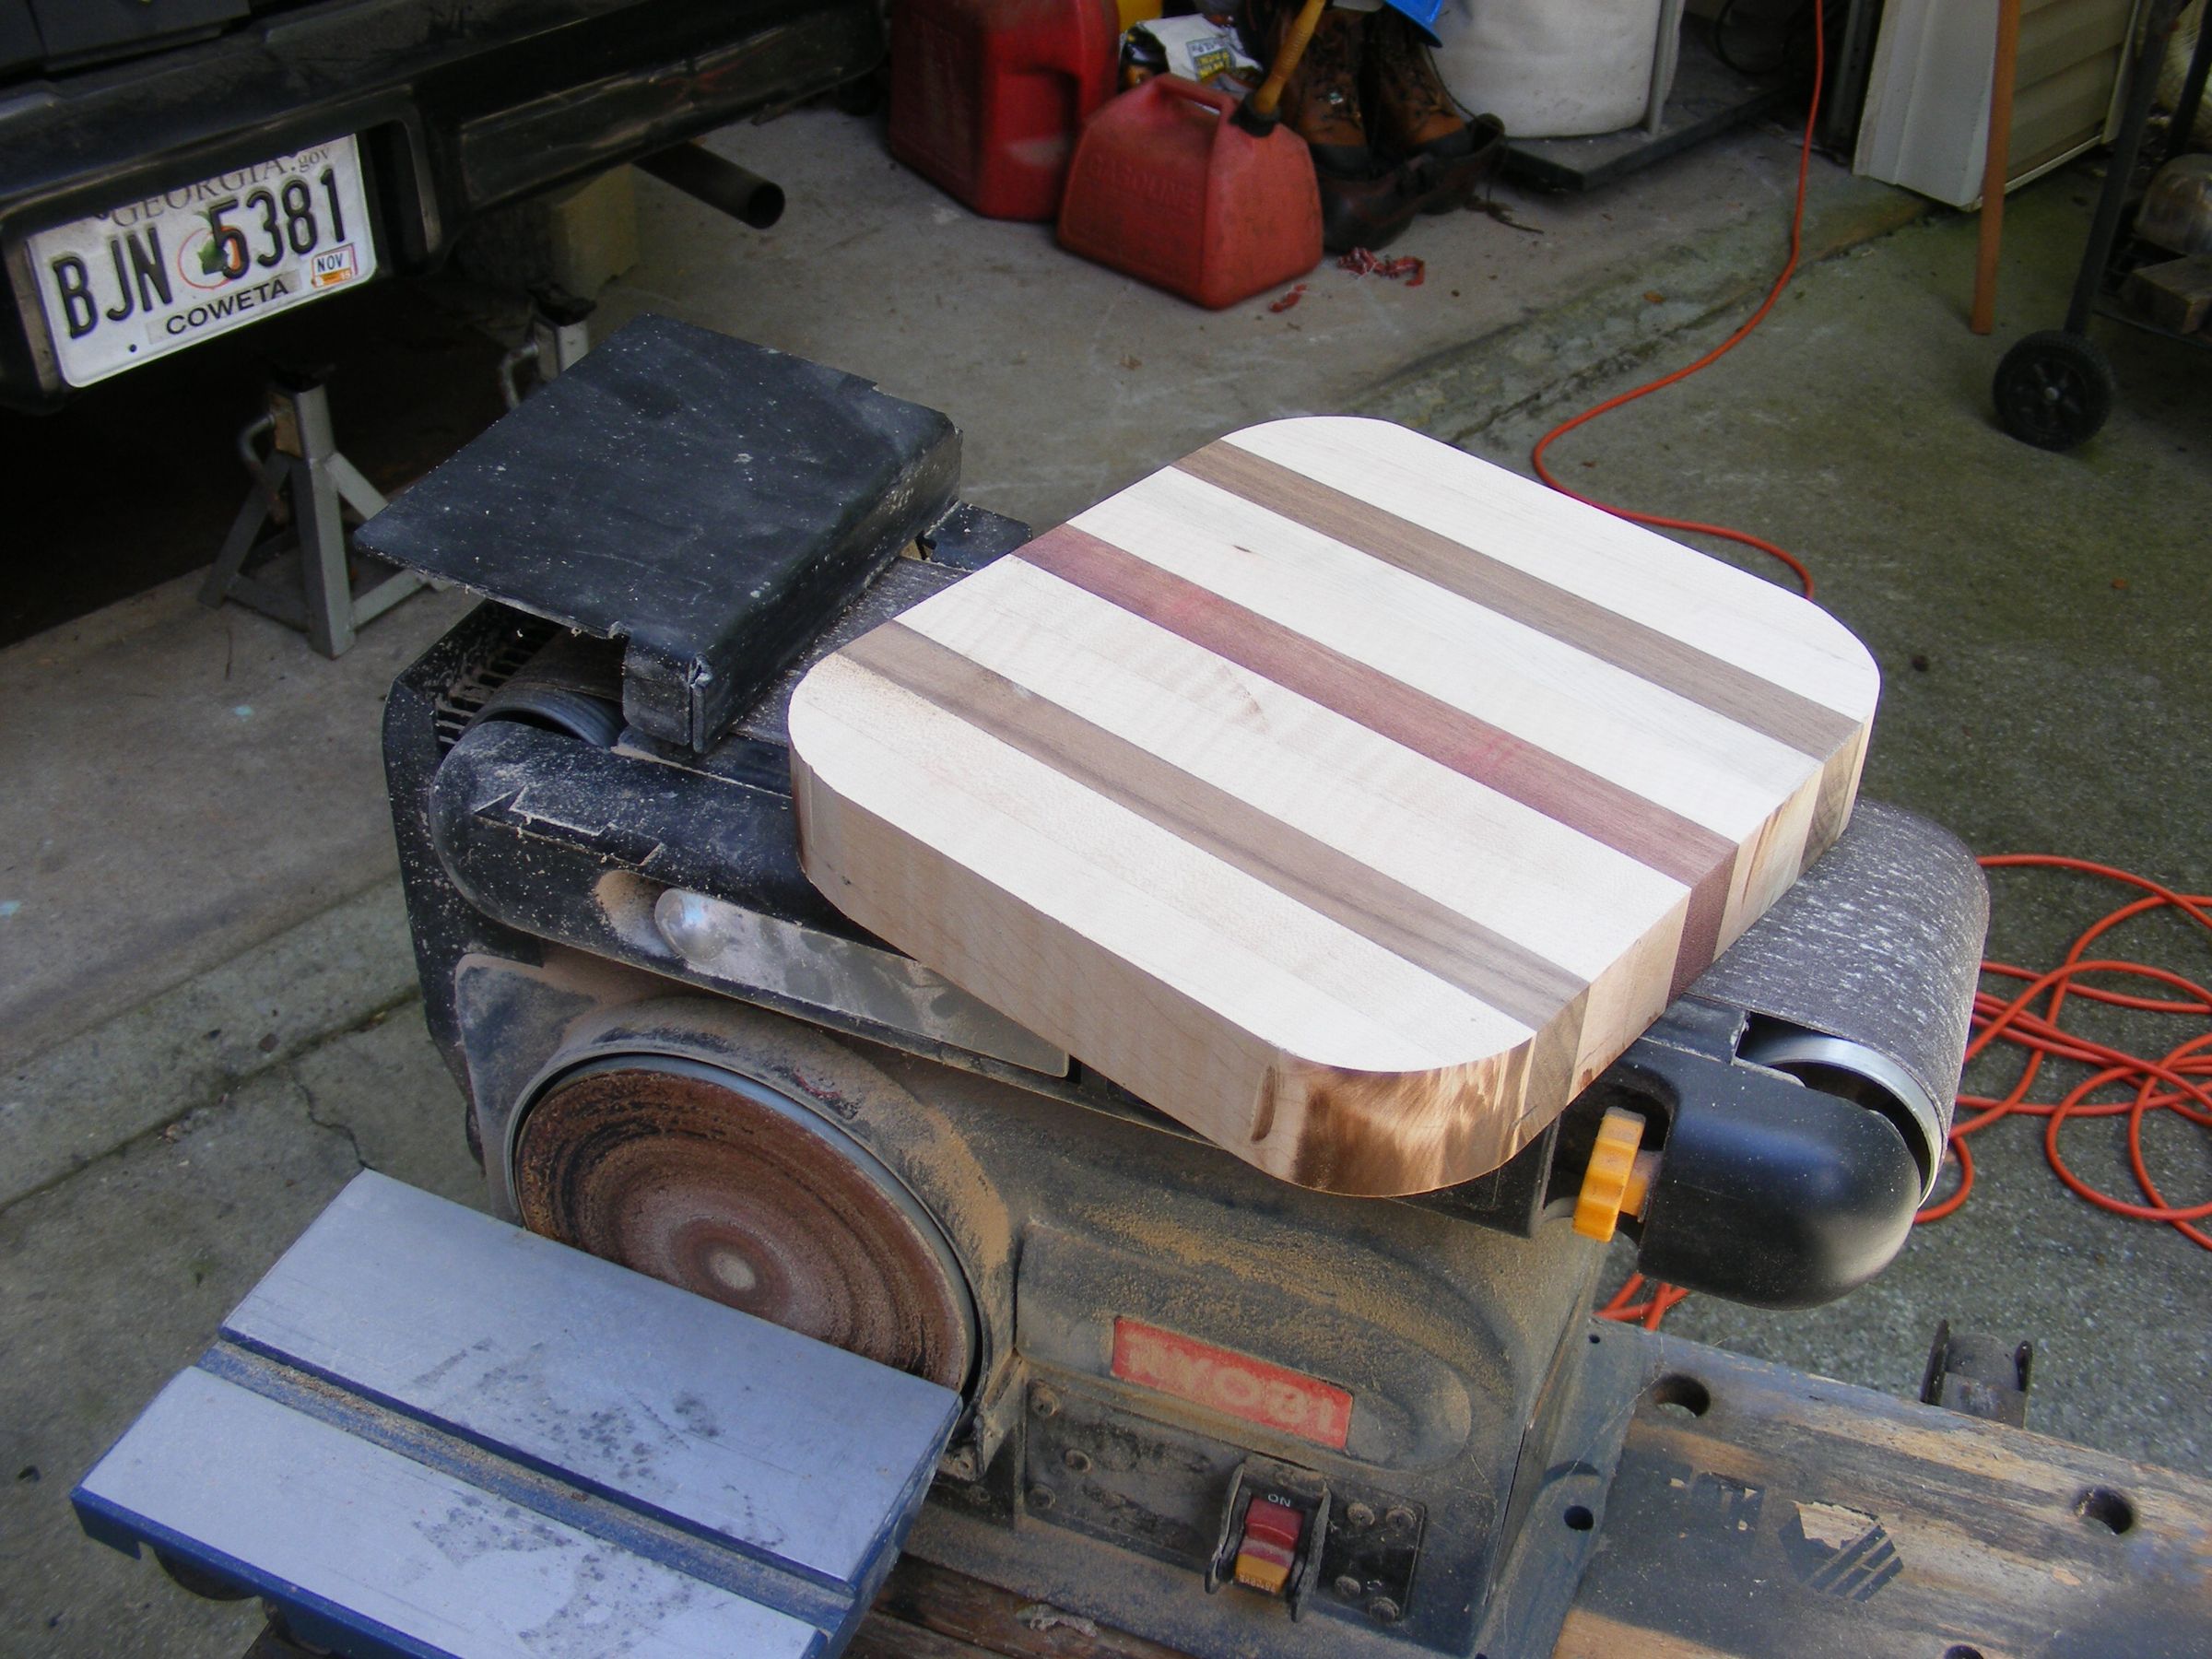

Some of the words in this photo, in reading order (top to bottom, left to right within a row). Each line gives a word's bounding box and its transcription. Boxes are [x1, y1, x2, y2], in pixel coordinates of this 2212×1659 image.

[53, 226, 173, 339] BJN
[209, 167, 346, 280] 5381
[316, 252, 344, 273] NOV
[166, 277, 289, 335] COWETA
[1267, 1493, 1291, 1508] ON
